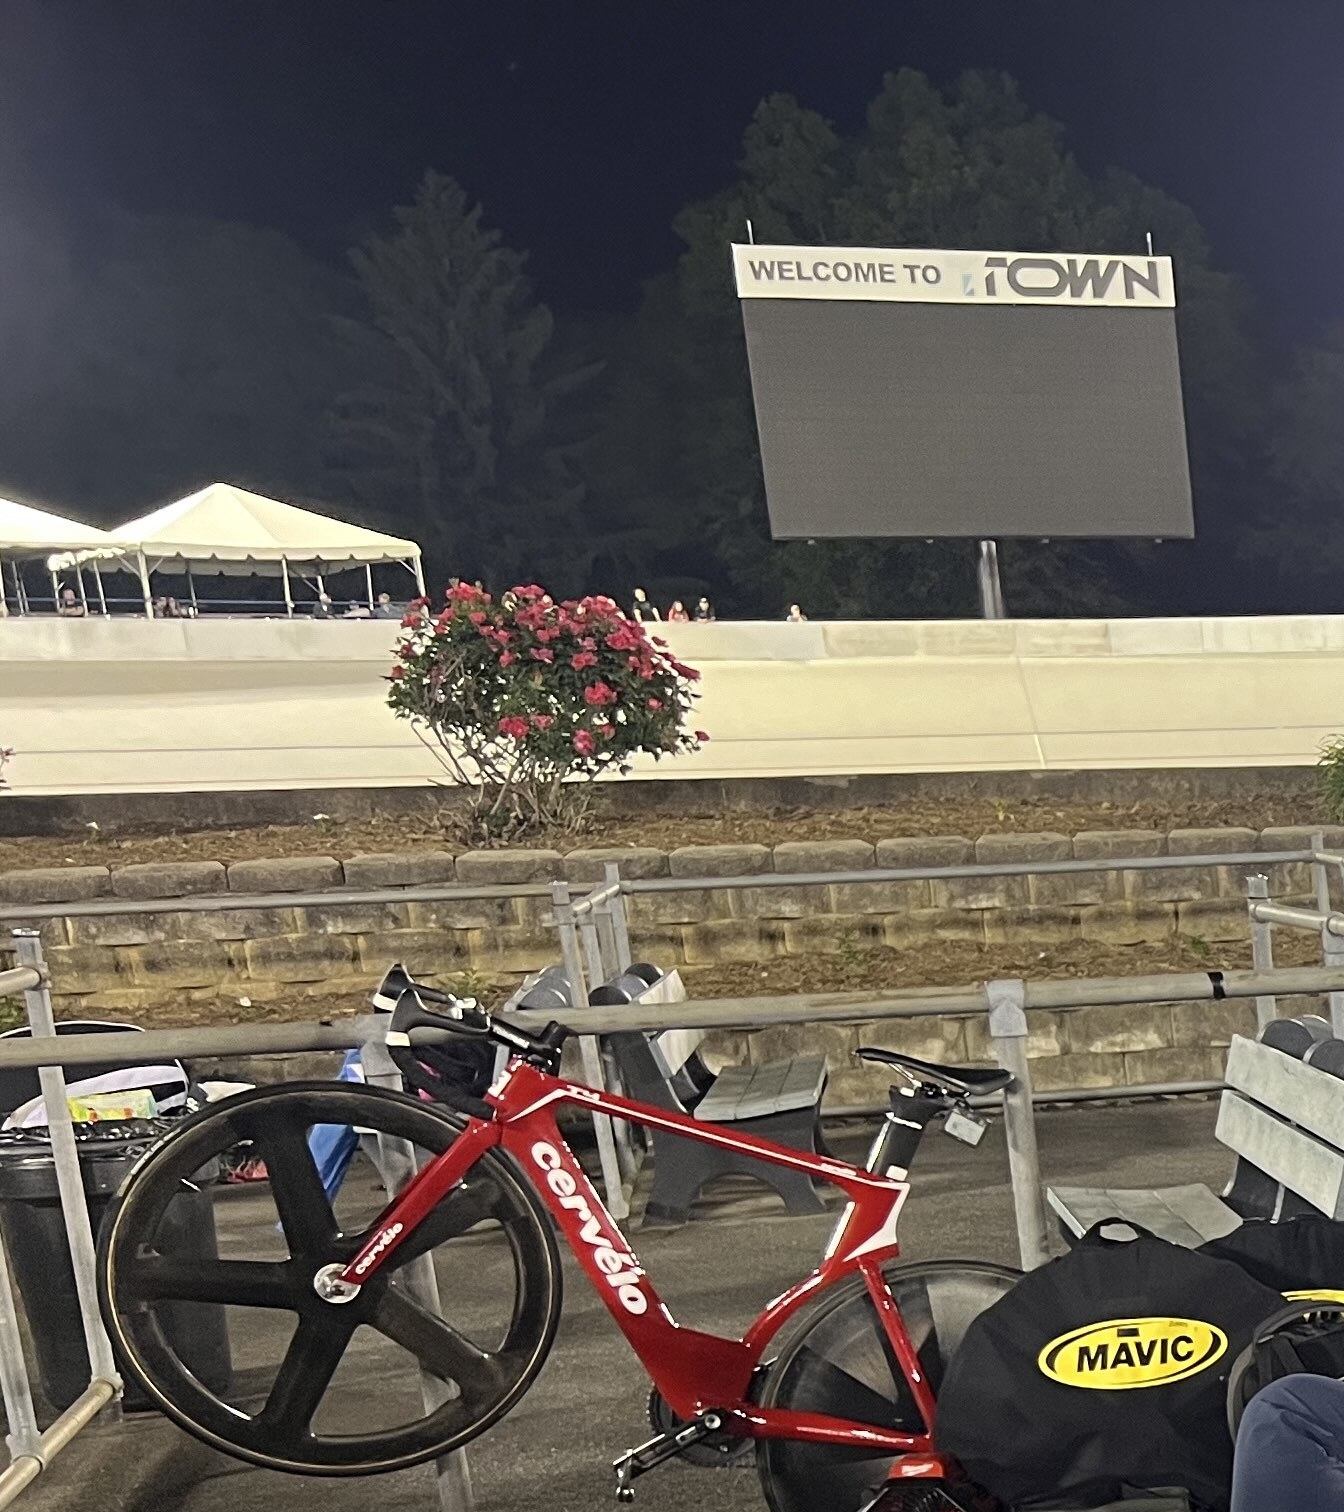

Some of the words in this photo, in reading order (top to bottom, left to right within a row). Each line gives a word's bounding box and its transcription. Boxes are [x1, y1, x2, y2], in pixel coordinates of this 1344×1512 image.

[748, 259, 895, 284] WELCOME
[903, 264, 942, 285] TO
[1077, 1335, 1195, 1373] MAVIC
